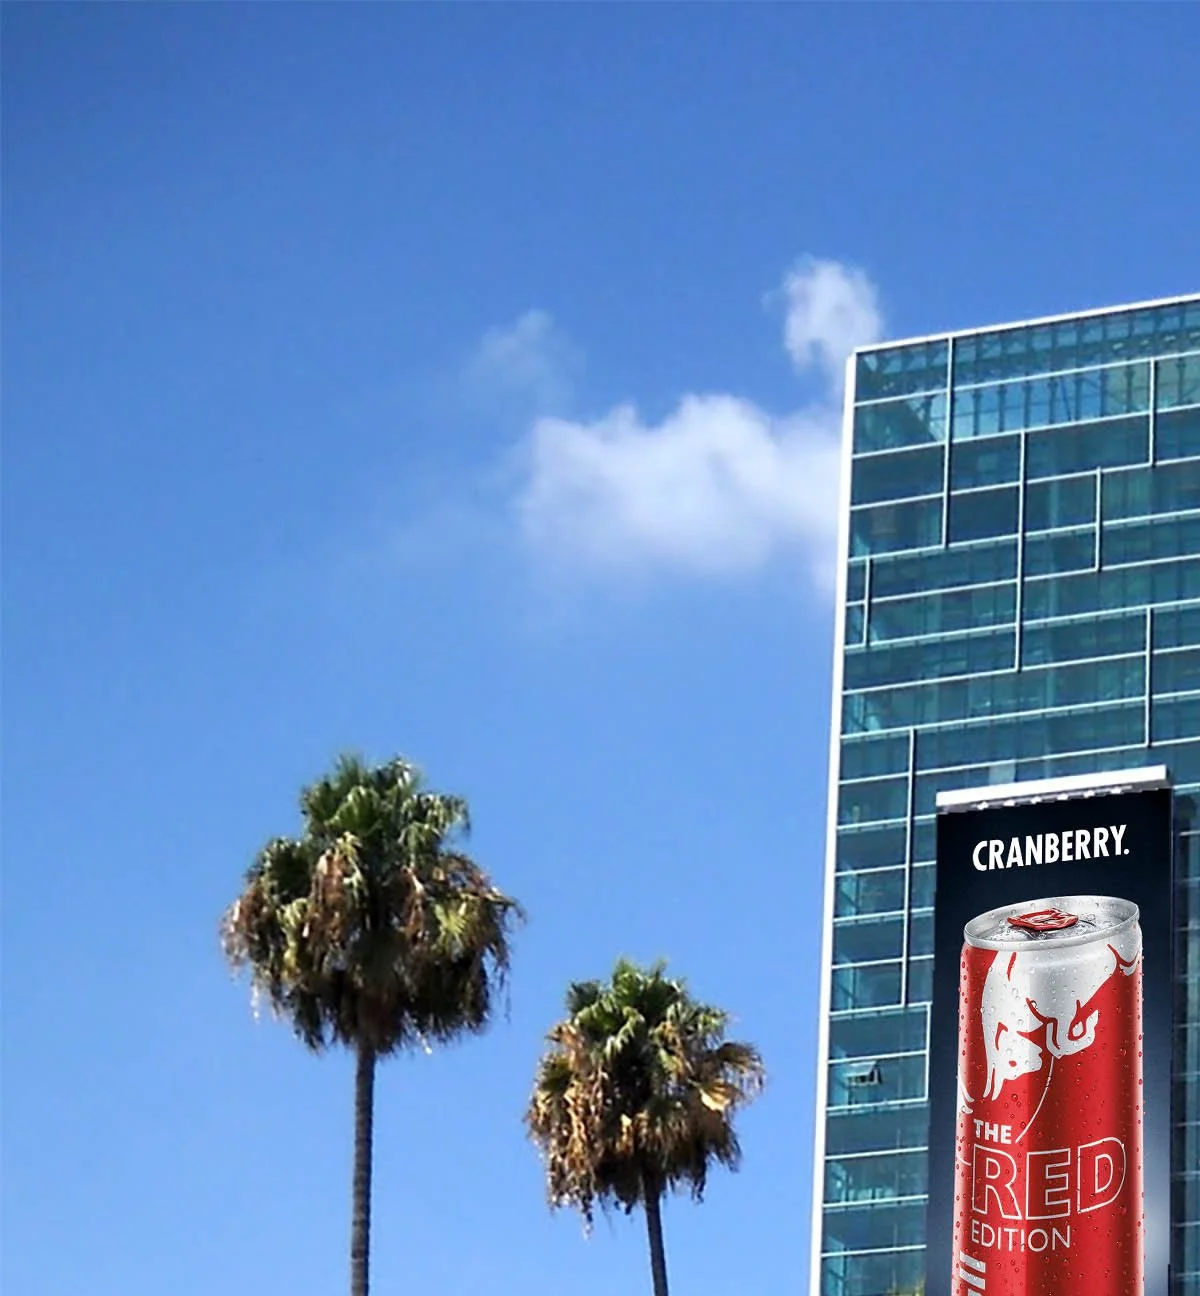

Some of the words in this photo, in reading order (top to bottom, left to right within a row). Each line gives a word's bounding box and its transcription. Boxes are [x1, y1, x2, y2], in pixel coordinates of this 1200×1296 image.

[972, 824, 1130, 871] CRANBERRY.
[973, 1118, 1012, 1144] THE
[971, 1136, 1127, 1220] RED
[971, 1222, 1071, 1253] EDITION
